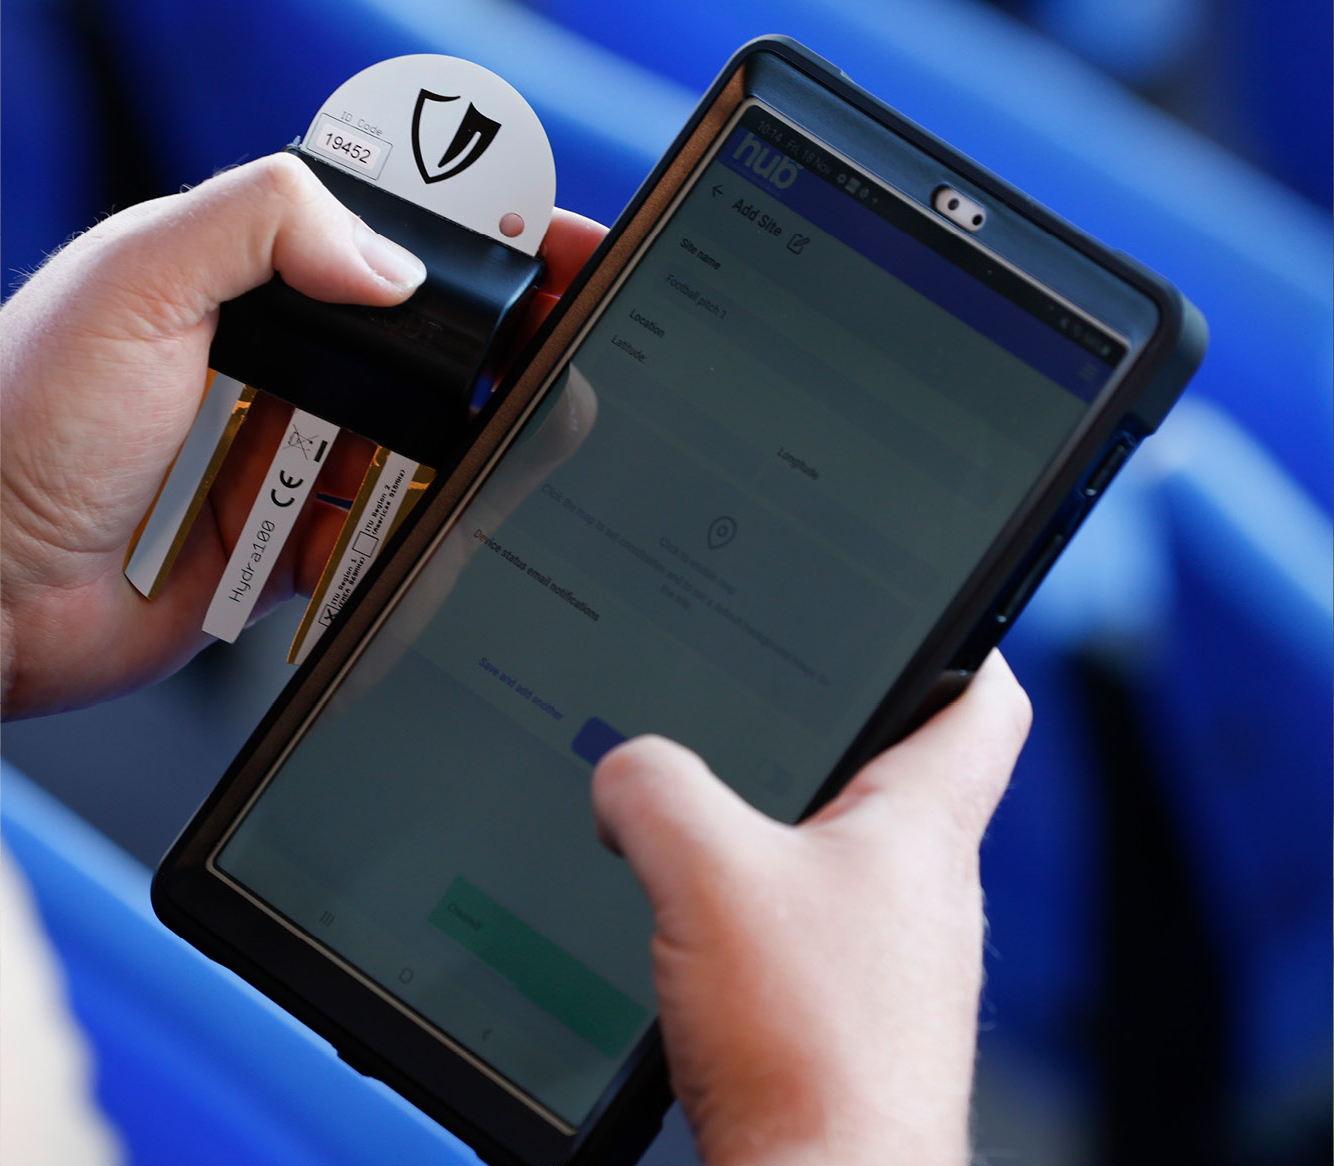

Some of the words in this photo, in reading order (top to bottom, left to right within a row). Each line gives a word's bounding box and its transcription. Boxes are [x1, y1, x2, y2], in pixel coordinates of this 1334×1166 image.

[341, 111, 353, 122] ID
[357, 118, 383, 136] Code
[325, 132, 371, 164] 19452
[731, 130, 799, 189] hub
[731, 198, 760, 221] Add
[757, 213, 783, 237] Site
[679, 237, 698, 255] Site
[697, 250, 721, 271] name
[628, 308, 665, 339] Location
[227, 519, 277, 604] Hydra100
[473, 529, 502, 553] Device
[500, 549, 528, 571] status
[526, 567, 552, 588] email
[549, 582, 601, 622] notifications
[478, 656, 500, 676] Save
